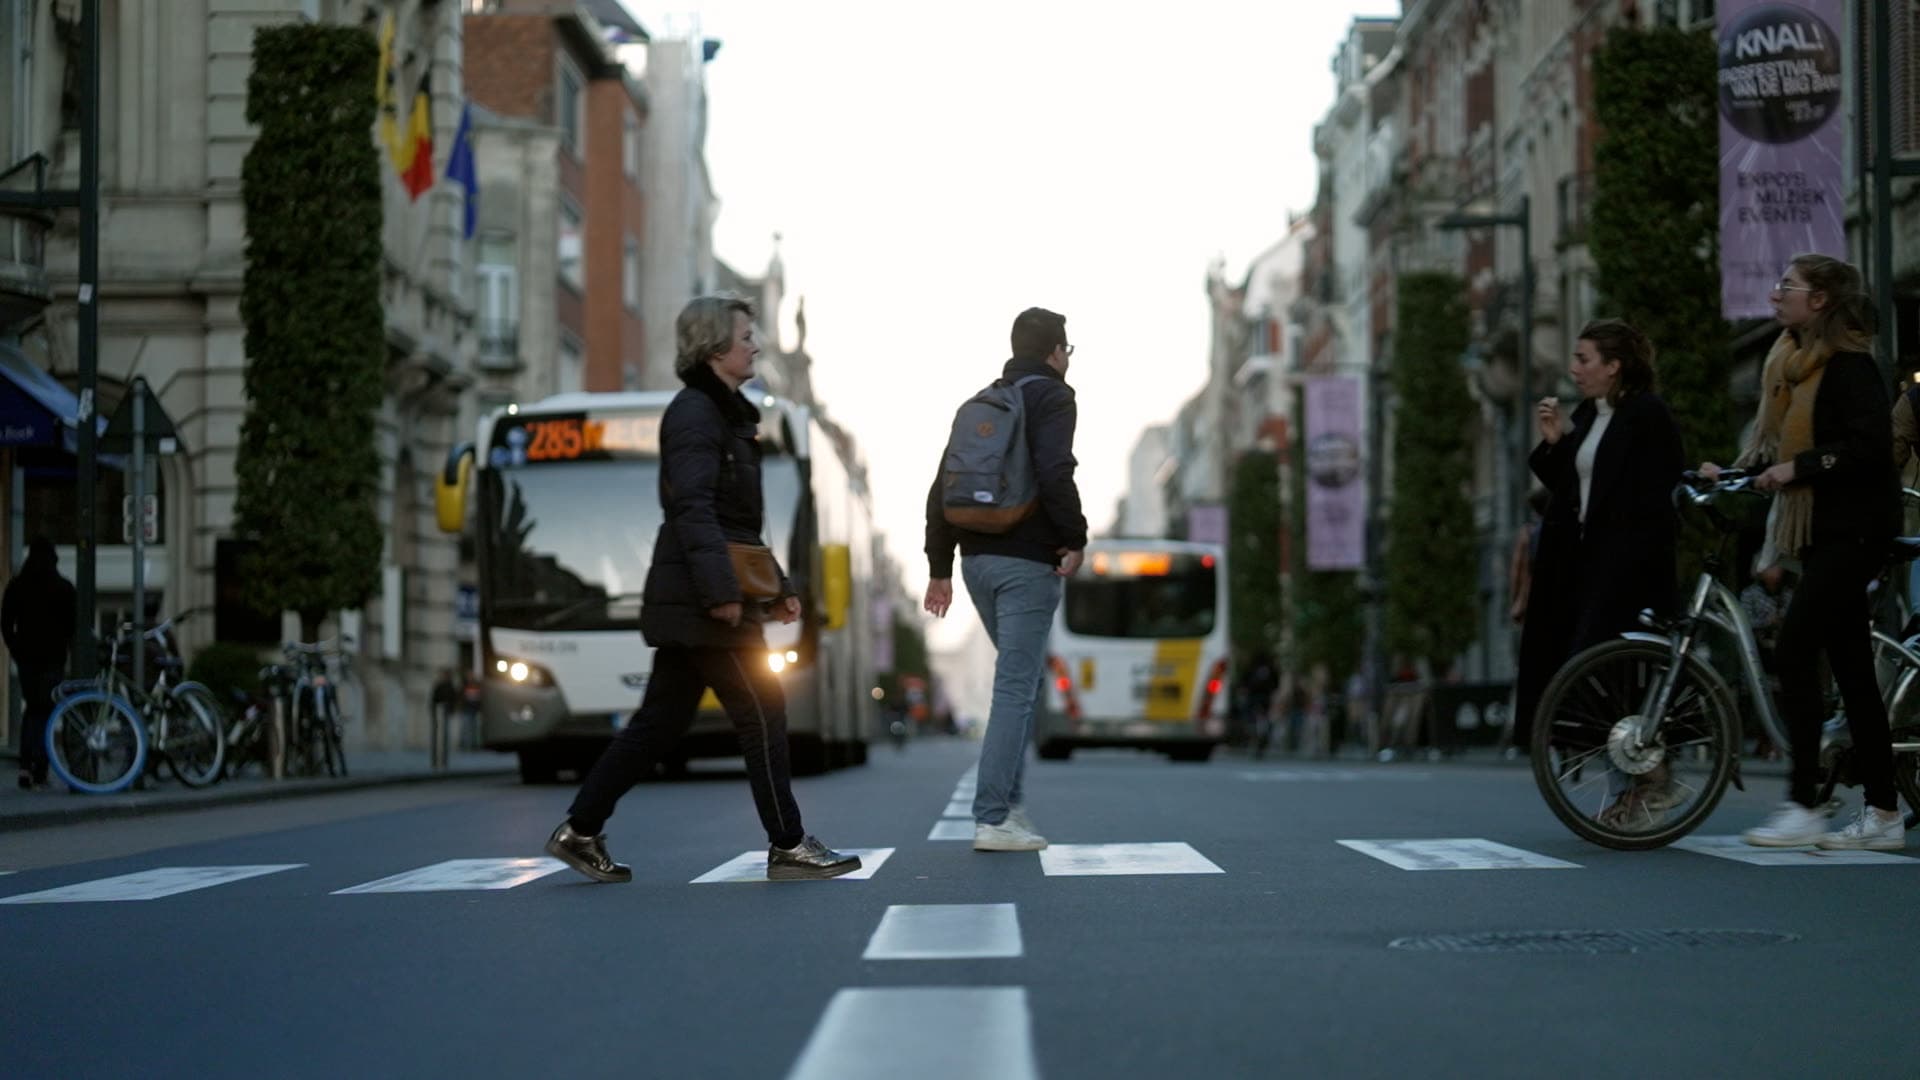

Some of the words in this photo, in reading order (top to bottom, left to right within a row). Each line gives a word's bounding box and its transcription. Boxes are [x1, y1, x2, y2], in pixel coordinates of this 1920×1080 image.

[1735, 22, 1824, 59] KNAL!
[1758, 75, 1782, 97] DE
[1756, 189, 1825, 205] MUZIEK
[1738, 206, 1813, 224] EVENTS
[526, 419, 583, 460] 285
